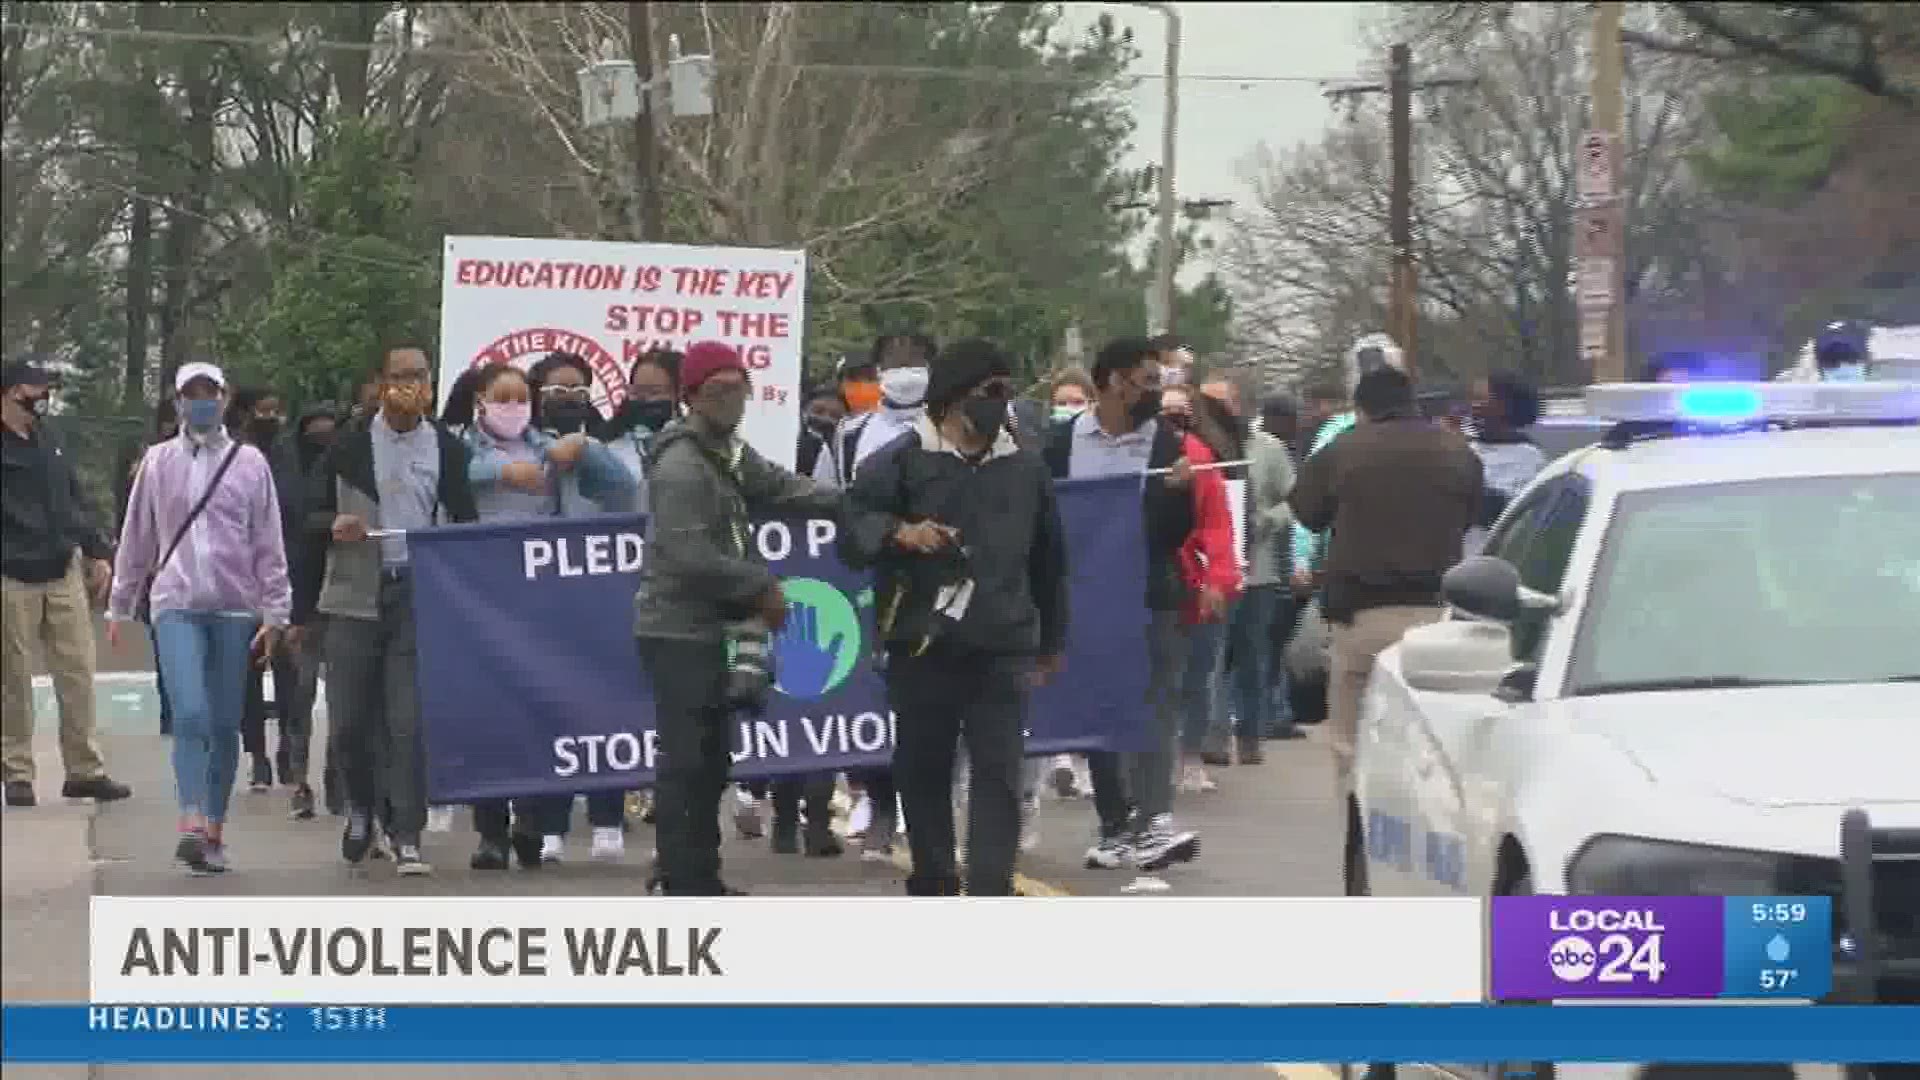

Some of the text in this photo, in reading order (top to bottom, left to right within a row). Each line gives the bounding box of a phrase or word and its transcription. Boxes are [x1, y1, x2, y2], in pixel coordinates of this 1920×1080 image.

[455, 259, 795, 299] EDUCATION IS THE KEY
[605, 304, 790, 338] STOP THE
[497, 332, 545, 359] THE
[554, 332, 627, 407] KILLING
[523, 533, 644, 580] PLED
[749, 521, 792, 561] O
